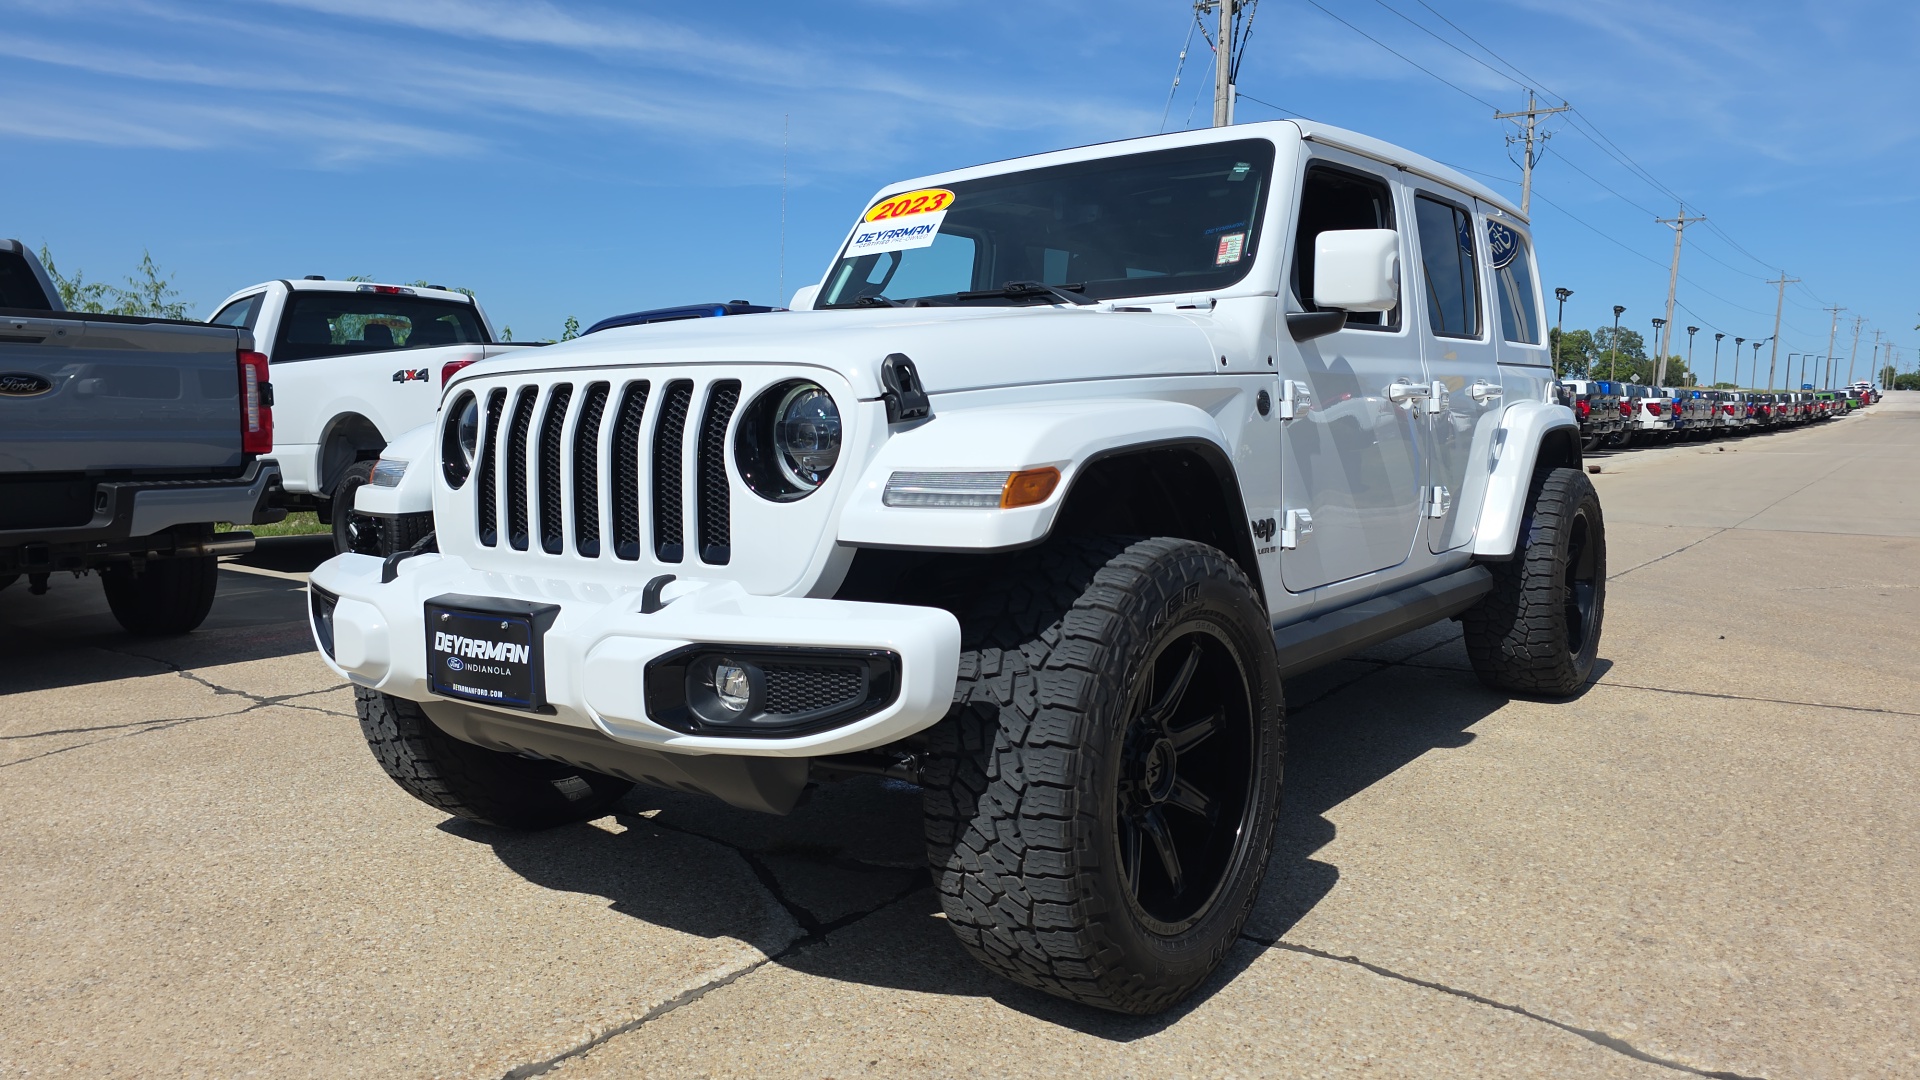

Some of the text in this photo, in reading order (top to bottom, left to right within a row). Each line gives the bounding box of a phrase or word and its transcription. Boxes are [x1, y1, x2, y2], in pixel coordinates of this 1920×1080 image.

[872, 193, 948, 221] 2023
[855, 224, 936, 244] DEYARMAN
[0, 376, 37, 391] Ford
[434, 631, 529, 664] DEYARMAN
[465, 663, 512, 676] INDIANOLA
[452, 683, 503, 698] DEYARMANFORD.COM
